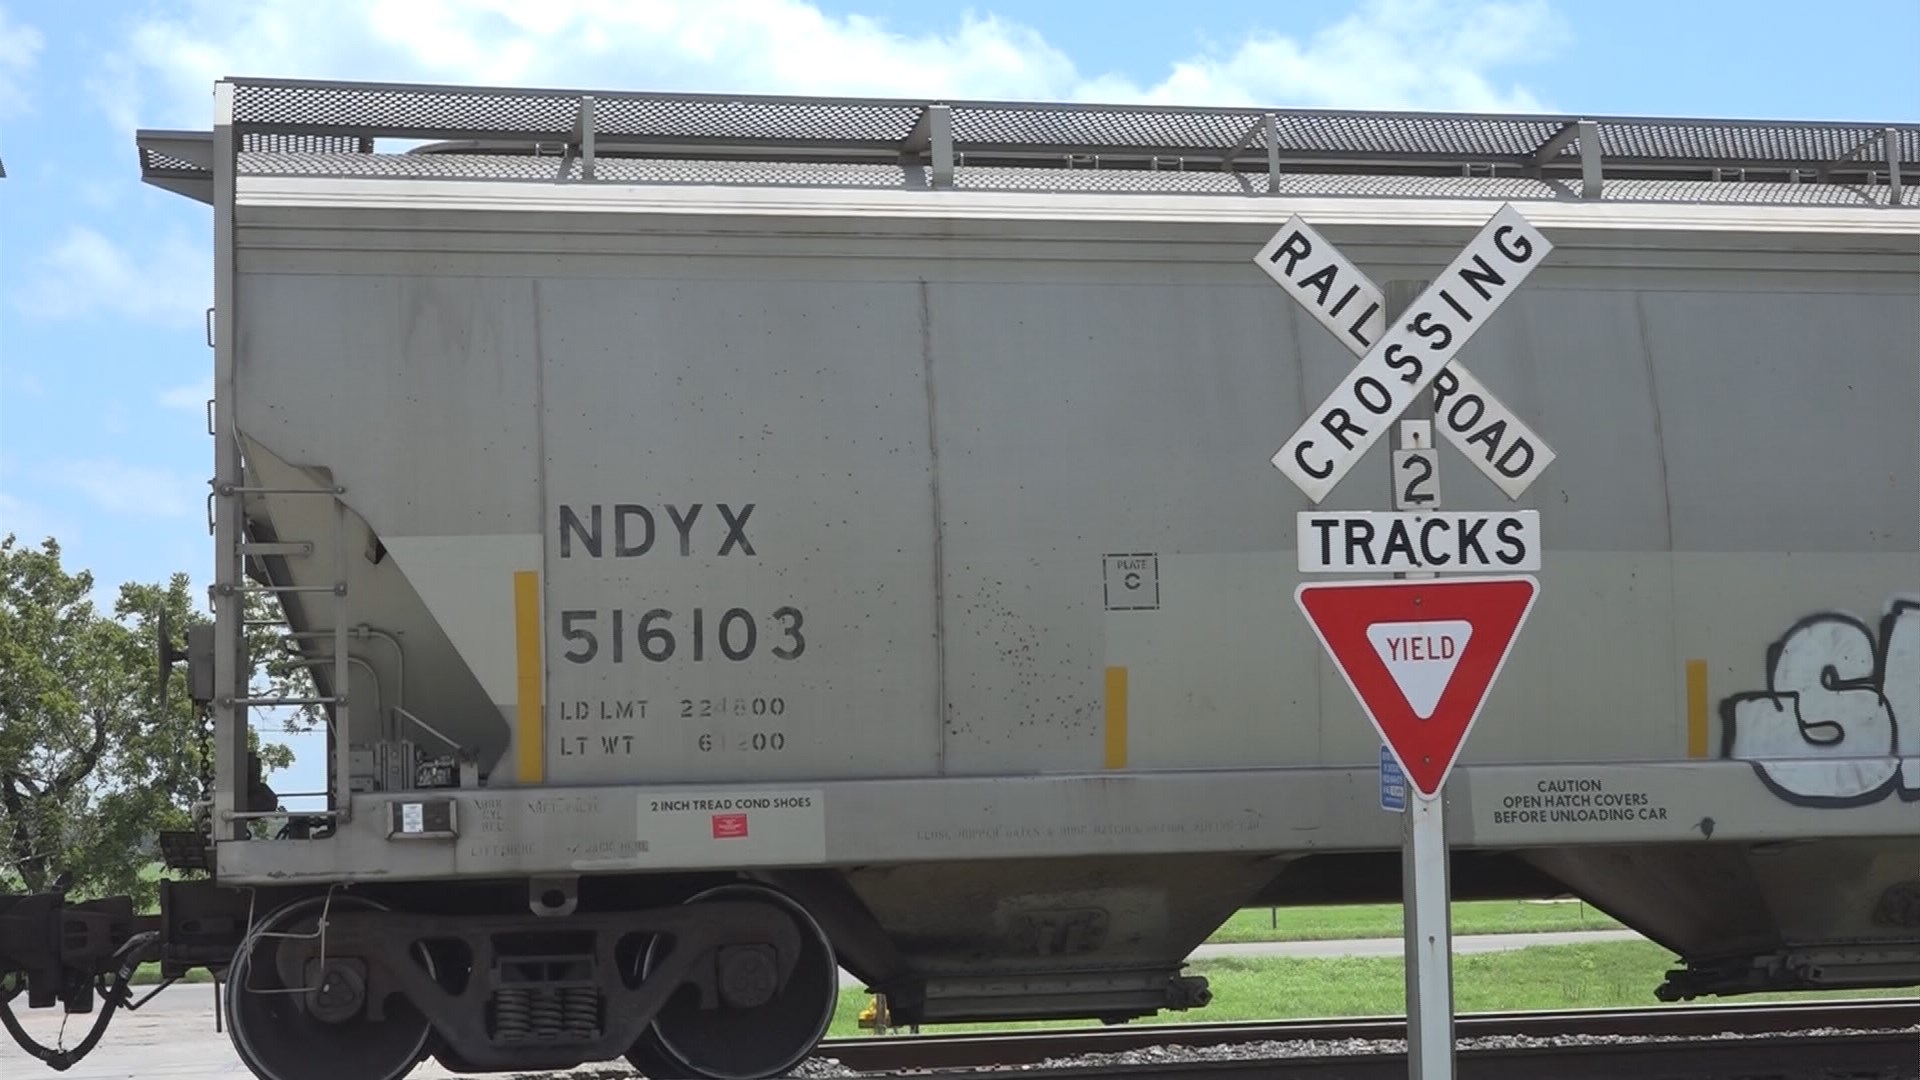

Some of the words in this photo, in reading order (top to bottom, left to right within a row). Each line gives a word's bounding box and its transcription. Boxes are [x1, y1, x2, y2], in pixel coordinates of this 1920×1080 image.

[1269, 229, 1380, 348] RAIL
[1432, 366, 1535, 479] ROAD
[1294, 225, 1533, 480] CROSSING
[1401, 454, 1435, 503] 2
[559, 503, 757, 558] NDYX
[1310, 517, 1527, 566] TRACKS
[1116, 559, 1146, 570] PLATE
[1124, 572, 1141, 590] C
[560, 605, 806, 664] 516103
[1386, 635, 1455, 662] YIELD
[560, 701, 590, 720] LD
[600, 700, 649, 720] LMT
[560, 736, 589, 756] LT
[601, 735, 635, 754] WT
[1537, 779, 1602, 793] CAUTION
[651, 801, 659, 812] 2
[661, 801, 690, 812] INCH
[693, 799, 732, 811] TREAD
[735, 798, 770, 810] COND
[774, 797, 812, 808] SHOES
[1503, 795, 1541, 809] OPEN
[1544, 794, 1591, 807] HATCH
[1594, 793, 1649, 806] COVERS
[1494, 810, 1547, 824] BEFORE
[1550, 808, 1635, 822] UNLOADING
[1638, 807, 1668, 820] CAR
